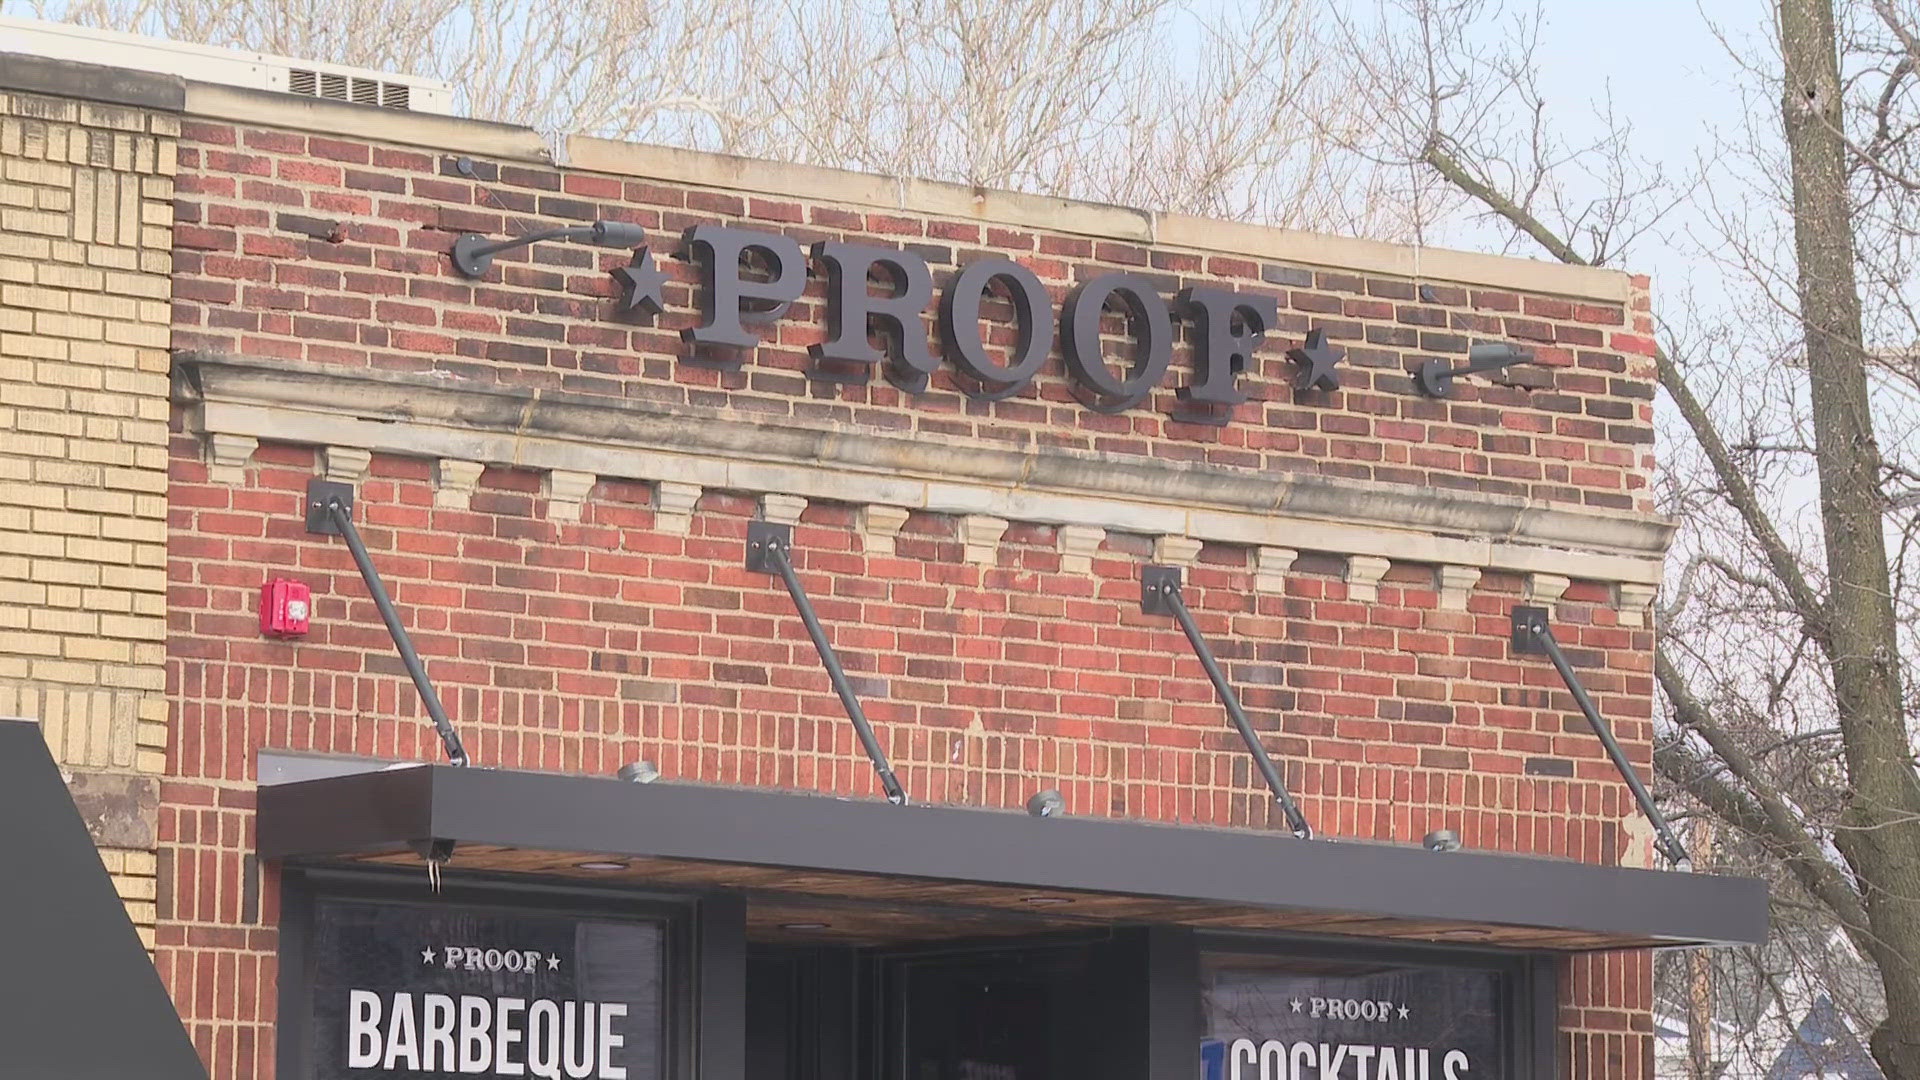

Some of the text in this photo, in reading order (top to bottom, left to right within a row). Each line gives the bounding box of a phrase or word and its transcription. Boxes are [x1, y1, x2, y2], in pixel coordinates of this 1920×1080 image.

[682, 225, 1277, 404] PROOF
[444, 946, 542, 974] PROOF
[348, 989, 628, 1080] BARBEQUE
[1309, 997, 1393, 1022] PROOF
